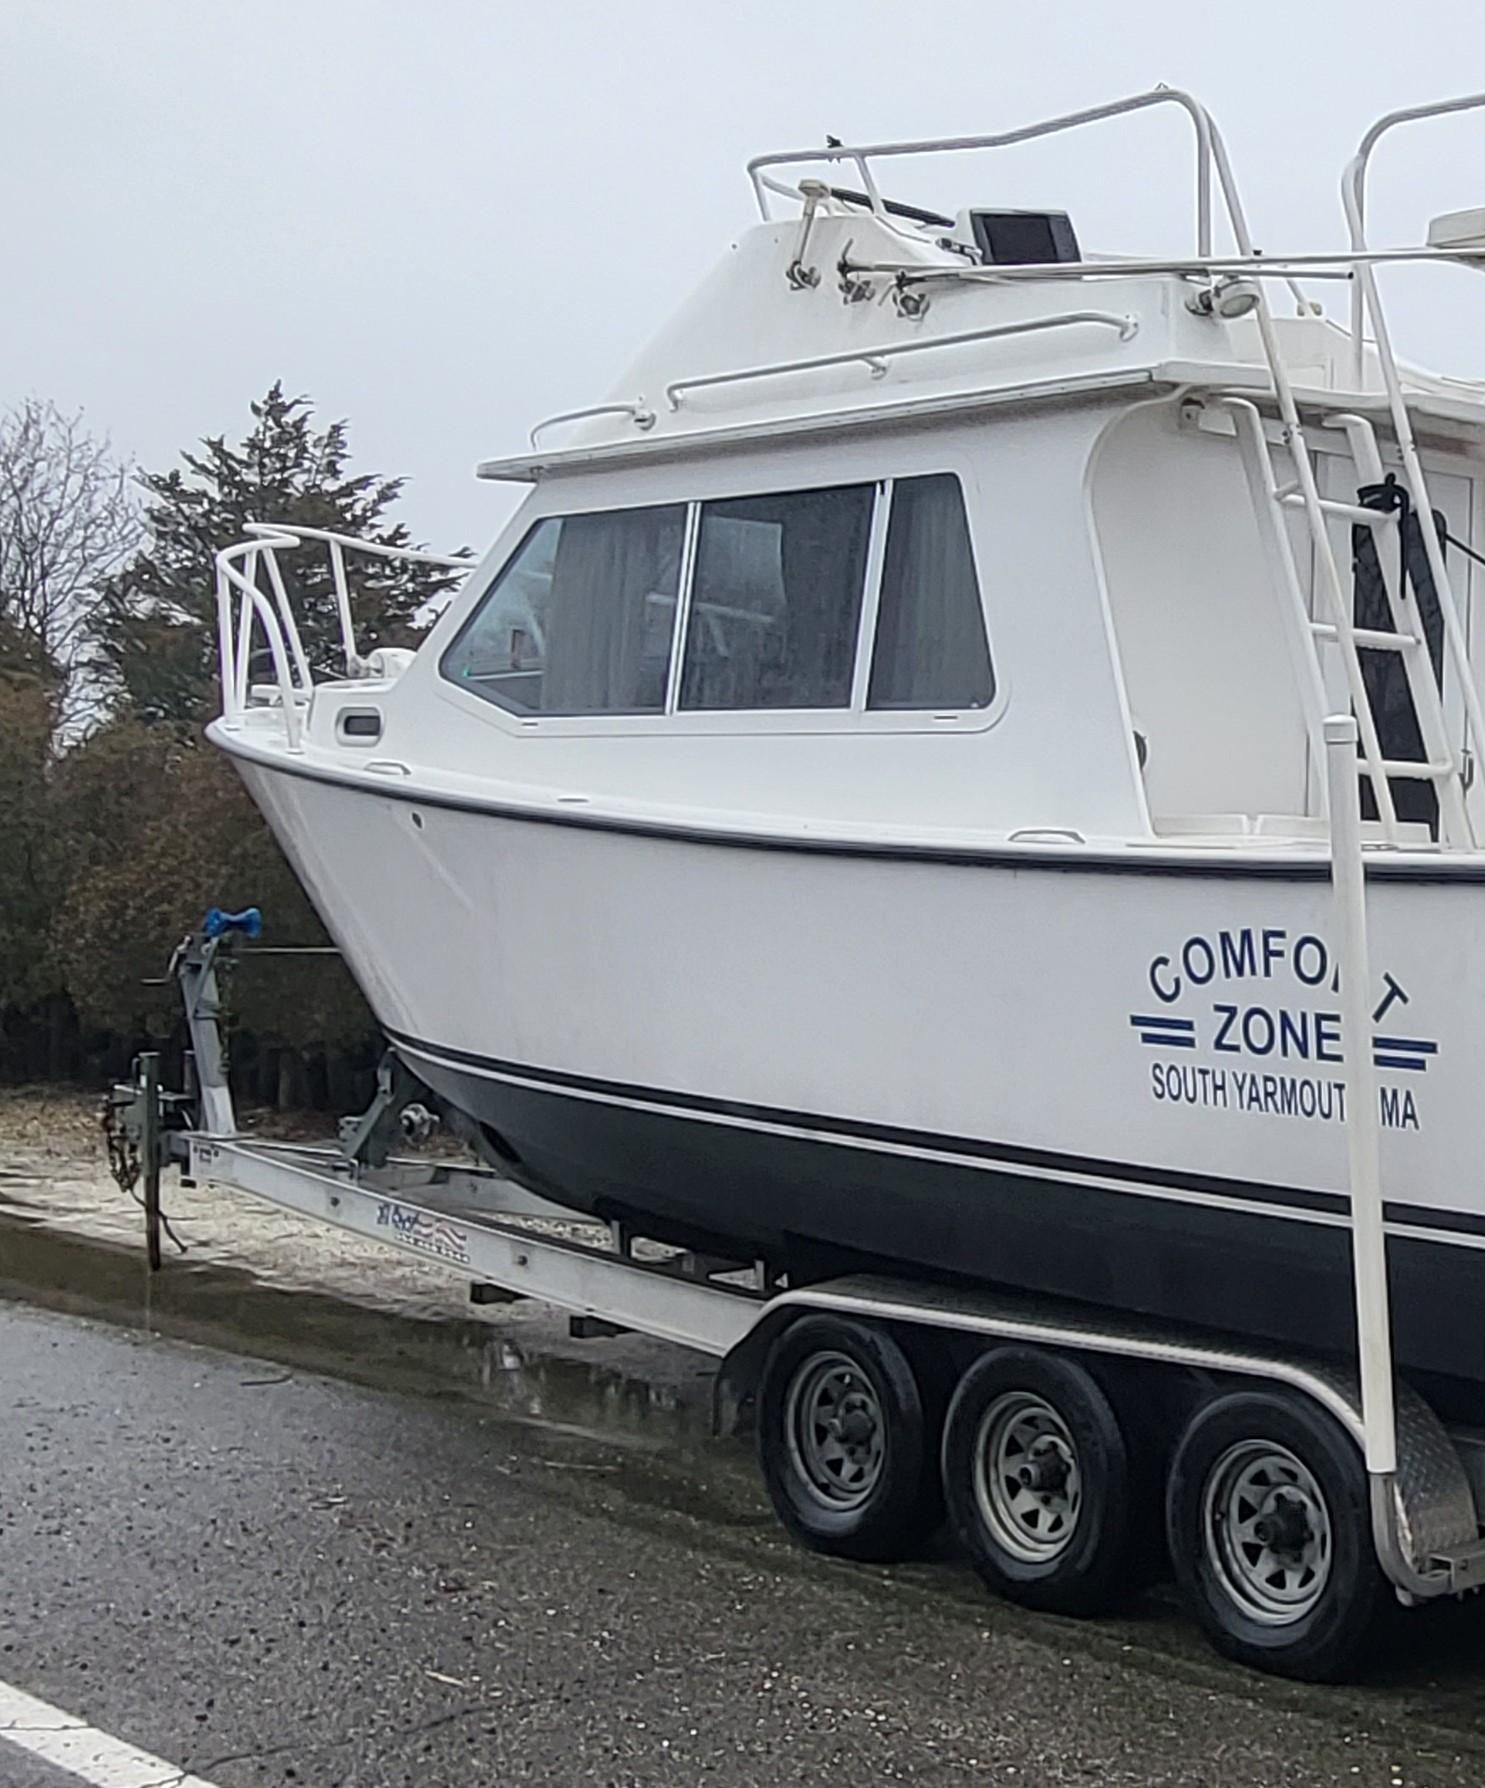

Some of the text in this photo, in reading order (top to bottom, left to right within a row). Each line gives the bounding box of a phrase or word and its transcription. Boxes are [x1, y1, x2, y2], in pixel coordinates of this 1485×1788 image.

[1150, 927, 1409, 1024] COMFOT
[1213, 1004, 1344, 1062] ZONE
[1152, 1062, 1420, 1131] SOUTH YARMOUT MA
